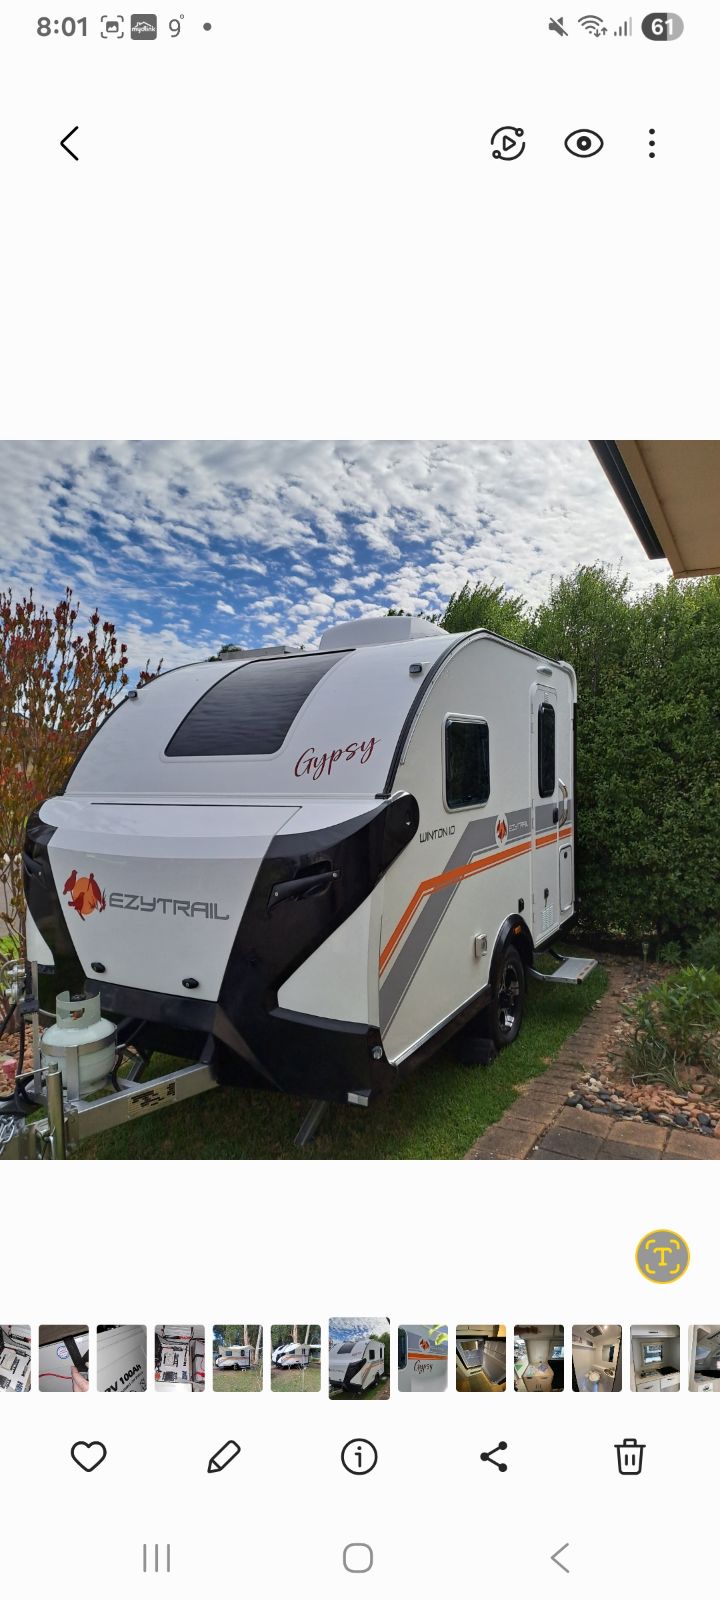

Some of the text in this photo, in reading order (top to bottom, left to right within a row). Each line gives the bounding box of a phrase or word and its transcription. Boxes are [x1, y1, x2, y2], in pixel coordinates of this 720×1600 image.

[36, 16, 88, 37] 8:01
[651, 18, 675, 36] 61
[294, 737, 381, 781] Gypsy
[419, 827, 448, 843] WINTON
[109, 892, 230, 921] EZYTRAIL
[119, 1364, 142, 1385] 100Ah
